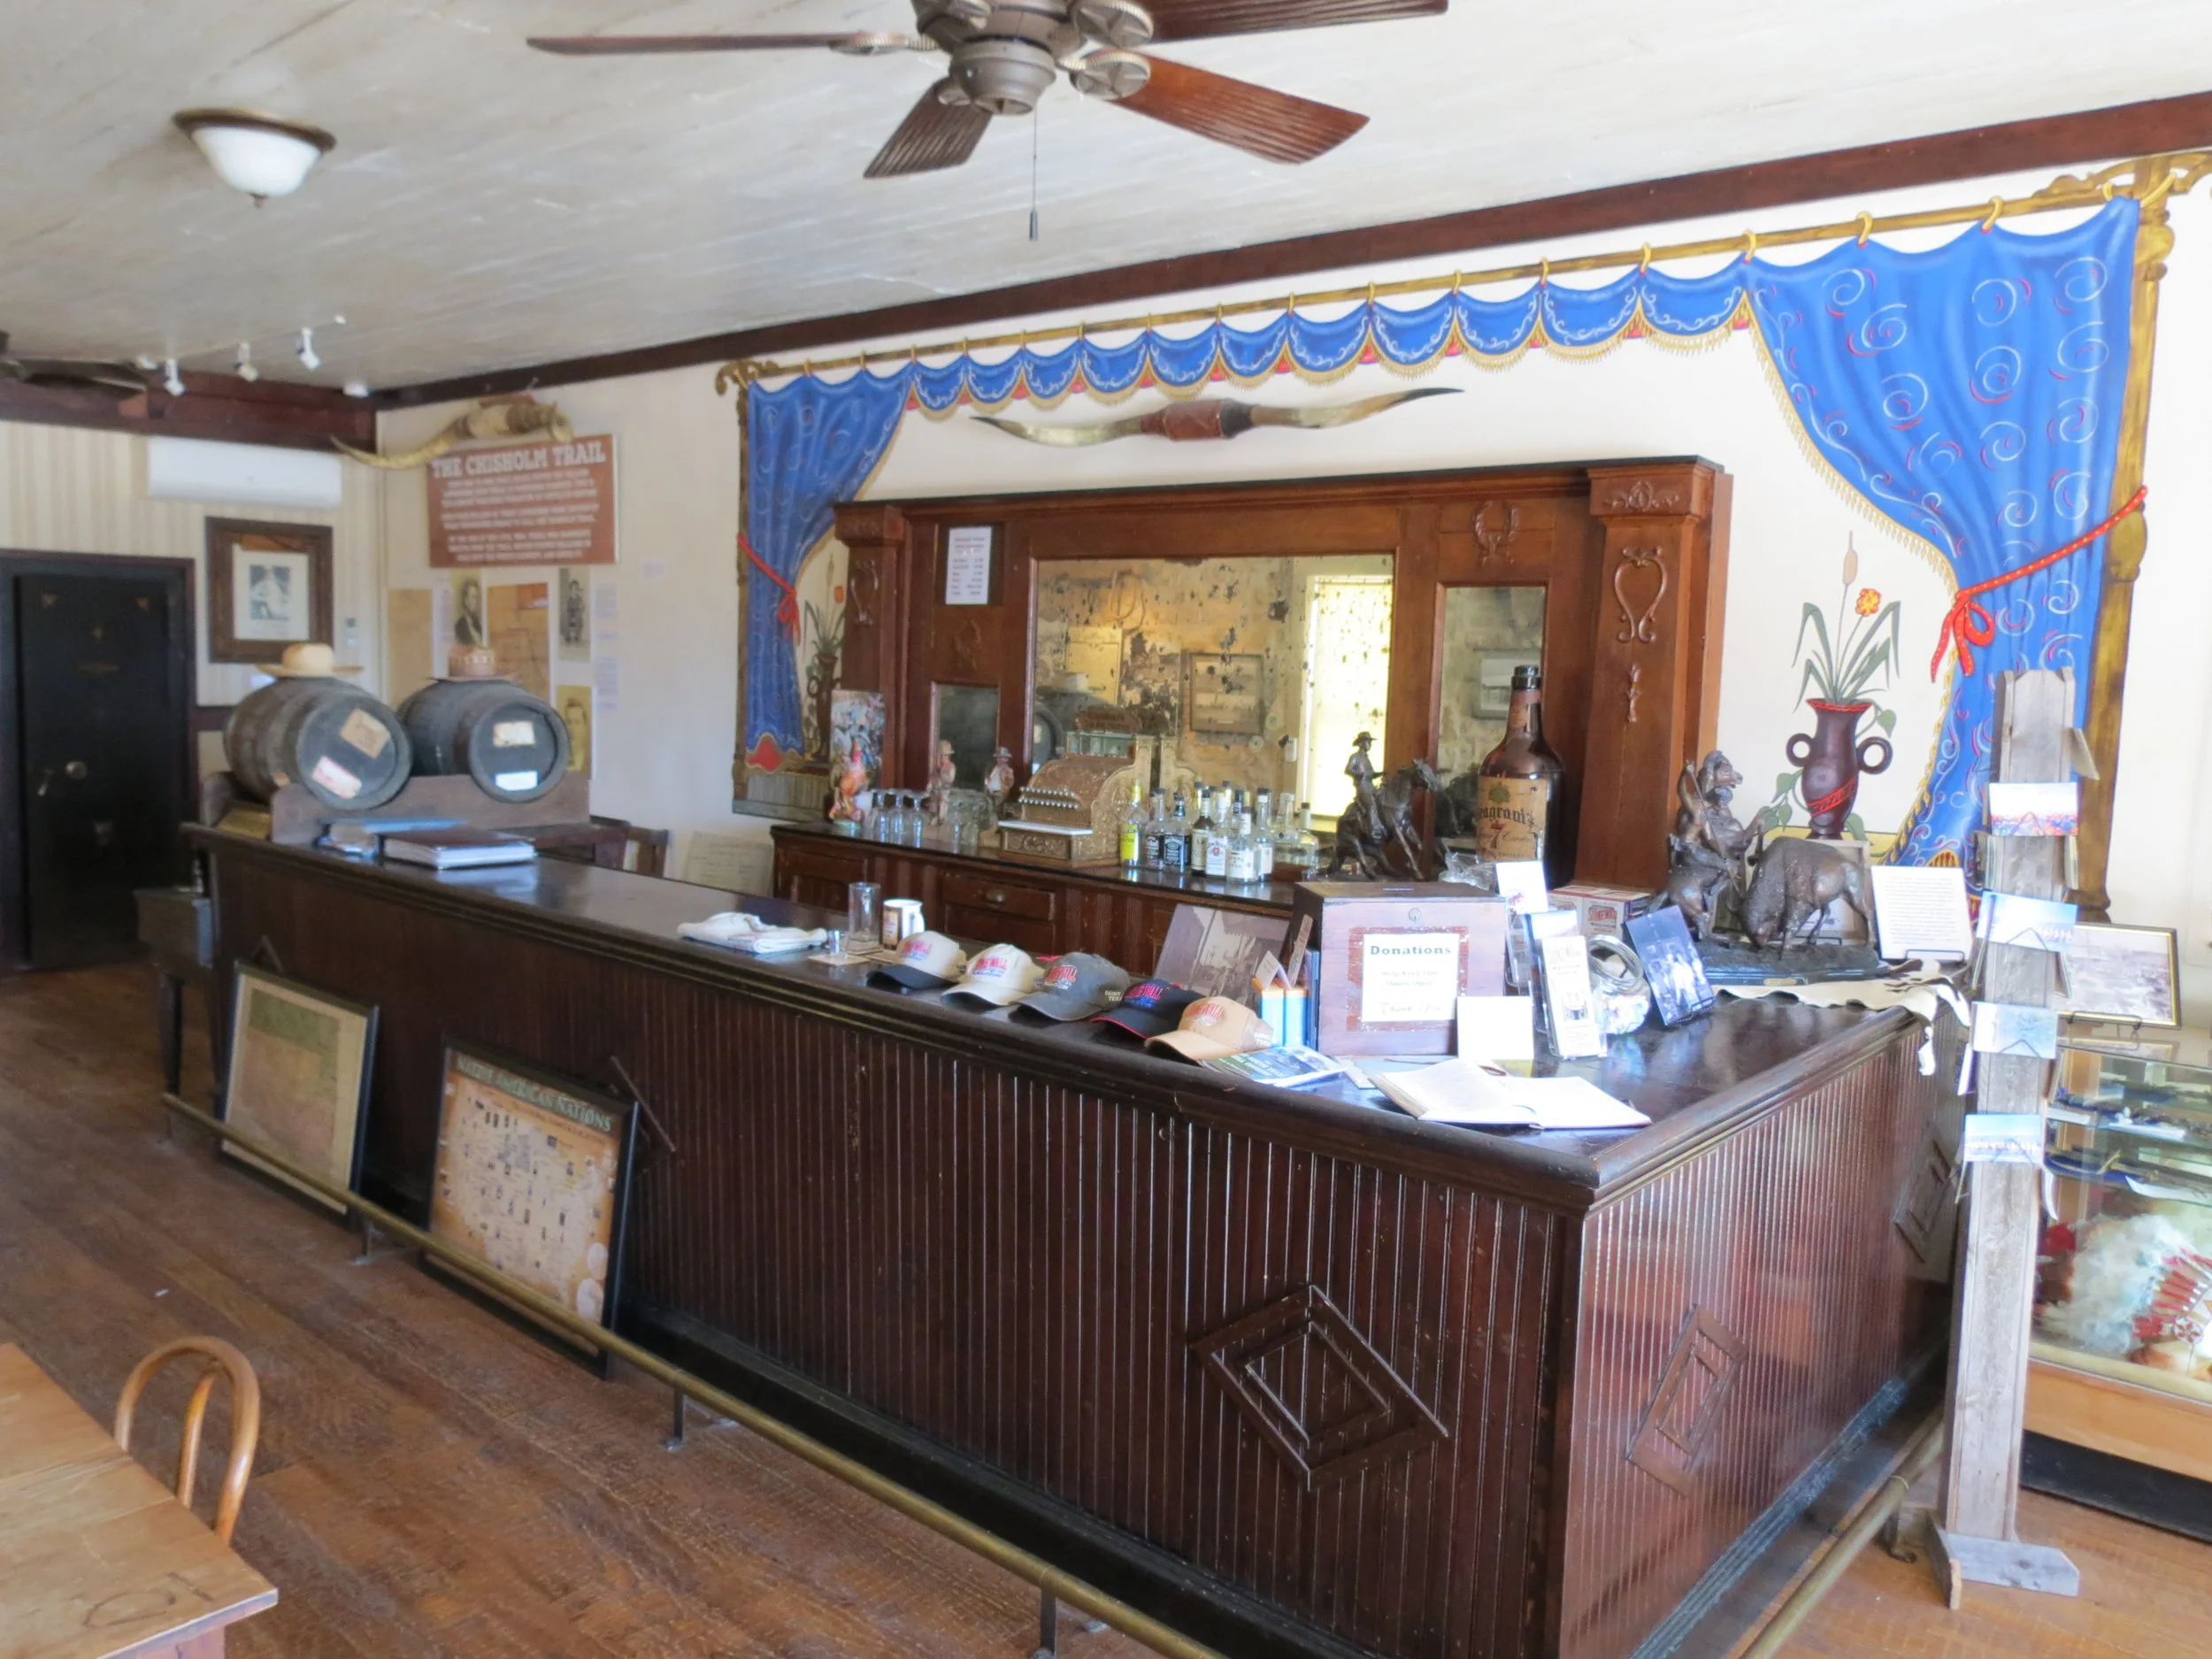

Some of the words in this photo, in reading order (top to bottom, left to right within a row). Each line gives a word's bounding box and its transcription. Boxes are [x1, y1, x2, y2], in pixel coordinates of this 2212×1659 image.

[432, 458, 462, 479] THE
[465, 449, 548, 475] CHISHOLM
[553, 441, 606, 467] TRAIL
[1479, 806, 1535, 827] eagram's
[1490, 823, 1507, 849] 7
[1370, 945, 1452, 956] Donations
[557, 1094, 612, 1132] NATIONS
